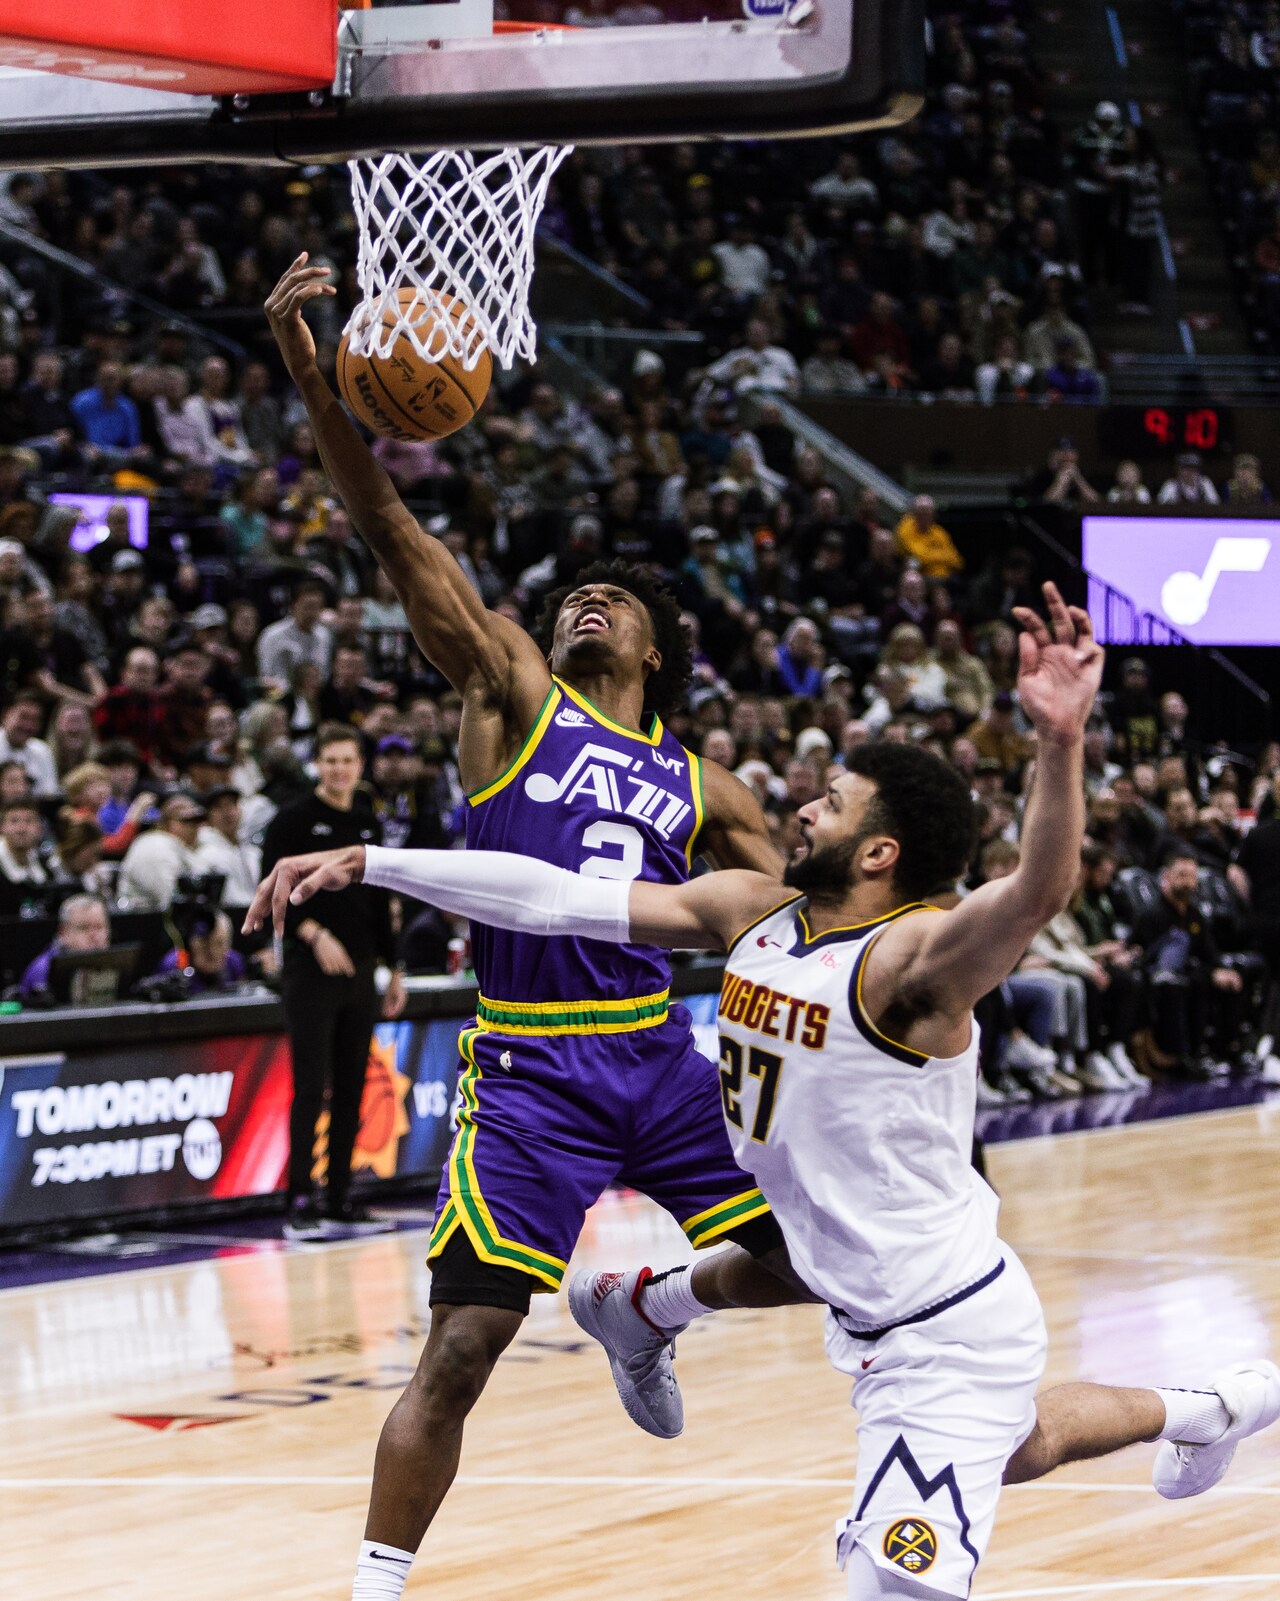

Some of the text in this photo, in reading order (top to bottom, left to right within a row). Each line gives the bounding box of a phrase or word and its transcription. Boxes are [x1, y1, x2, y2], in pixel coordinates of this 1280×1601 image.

[561, 707, 586, 723] NIKE
[580, 820, 644, 881] 2
[718, 970, 831, 1051] UGGETS
[11, 1071, 234, 1138] TOMORROW
[413, 1081, 448, 1118] VS
[718, 1033, 784, 1145] 27
[139, 1133, 182, 1174] ET
